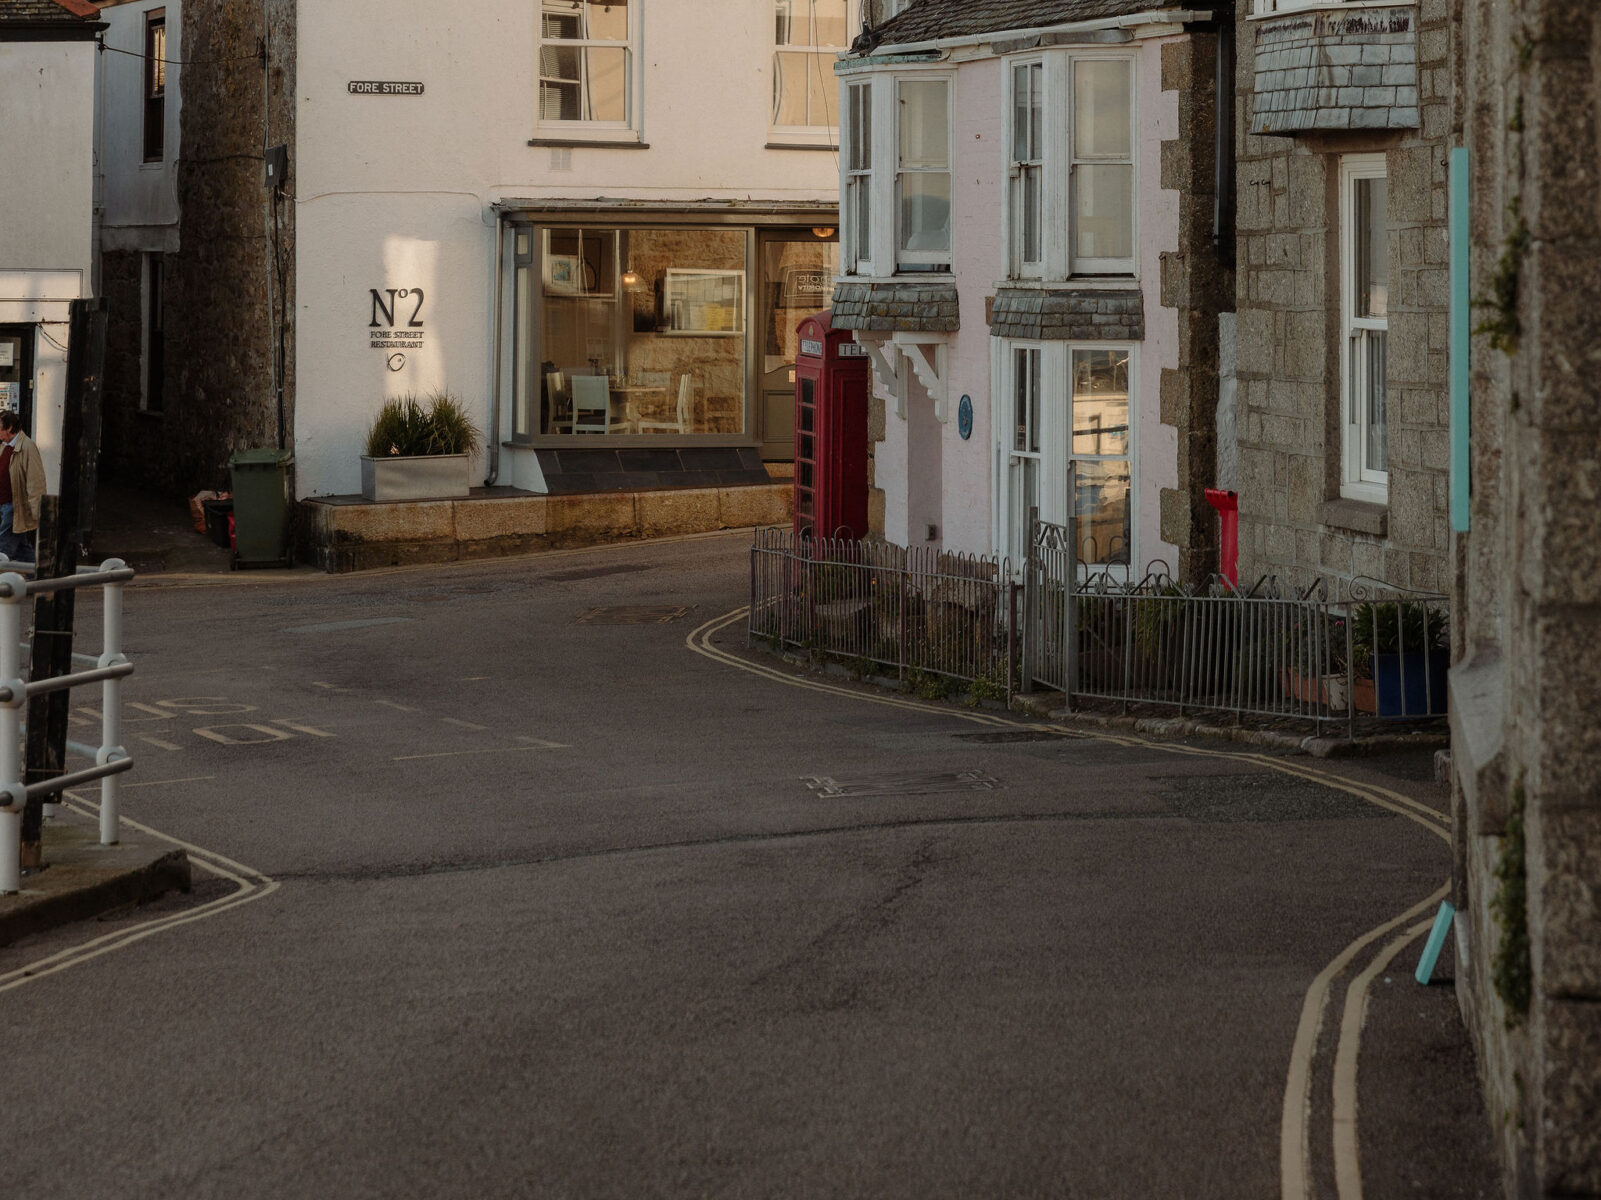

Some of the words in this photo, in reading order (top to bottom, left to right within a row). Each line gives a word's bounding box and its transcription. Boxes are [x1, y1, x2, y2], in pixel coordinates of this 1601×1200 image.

[350, 82, 380, 93] FORE
[382, 83, 423, 94] STREET
[370, 331, 392, 339] FORE
[393, 331, 425, 339] STREET
[370, 340, 425, 349] RESTAURANT
